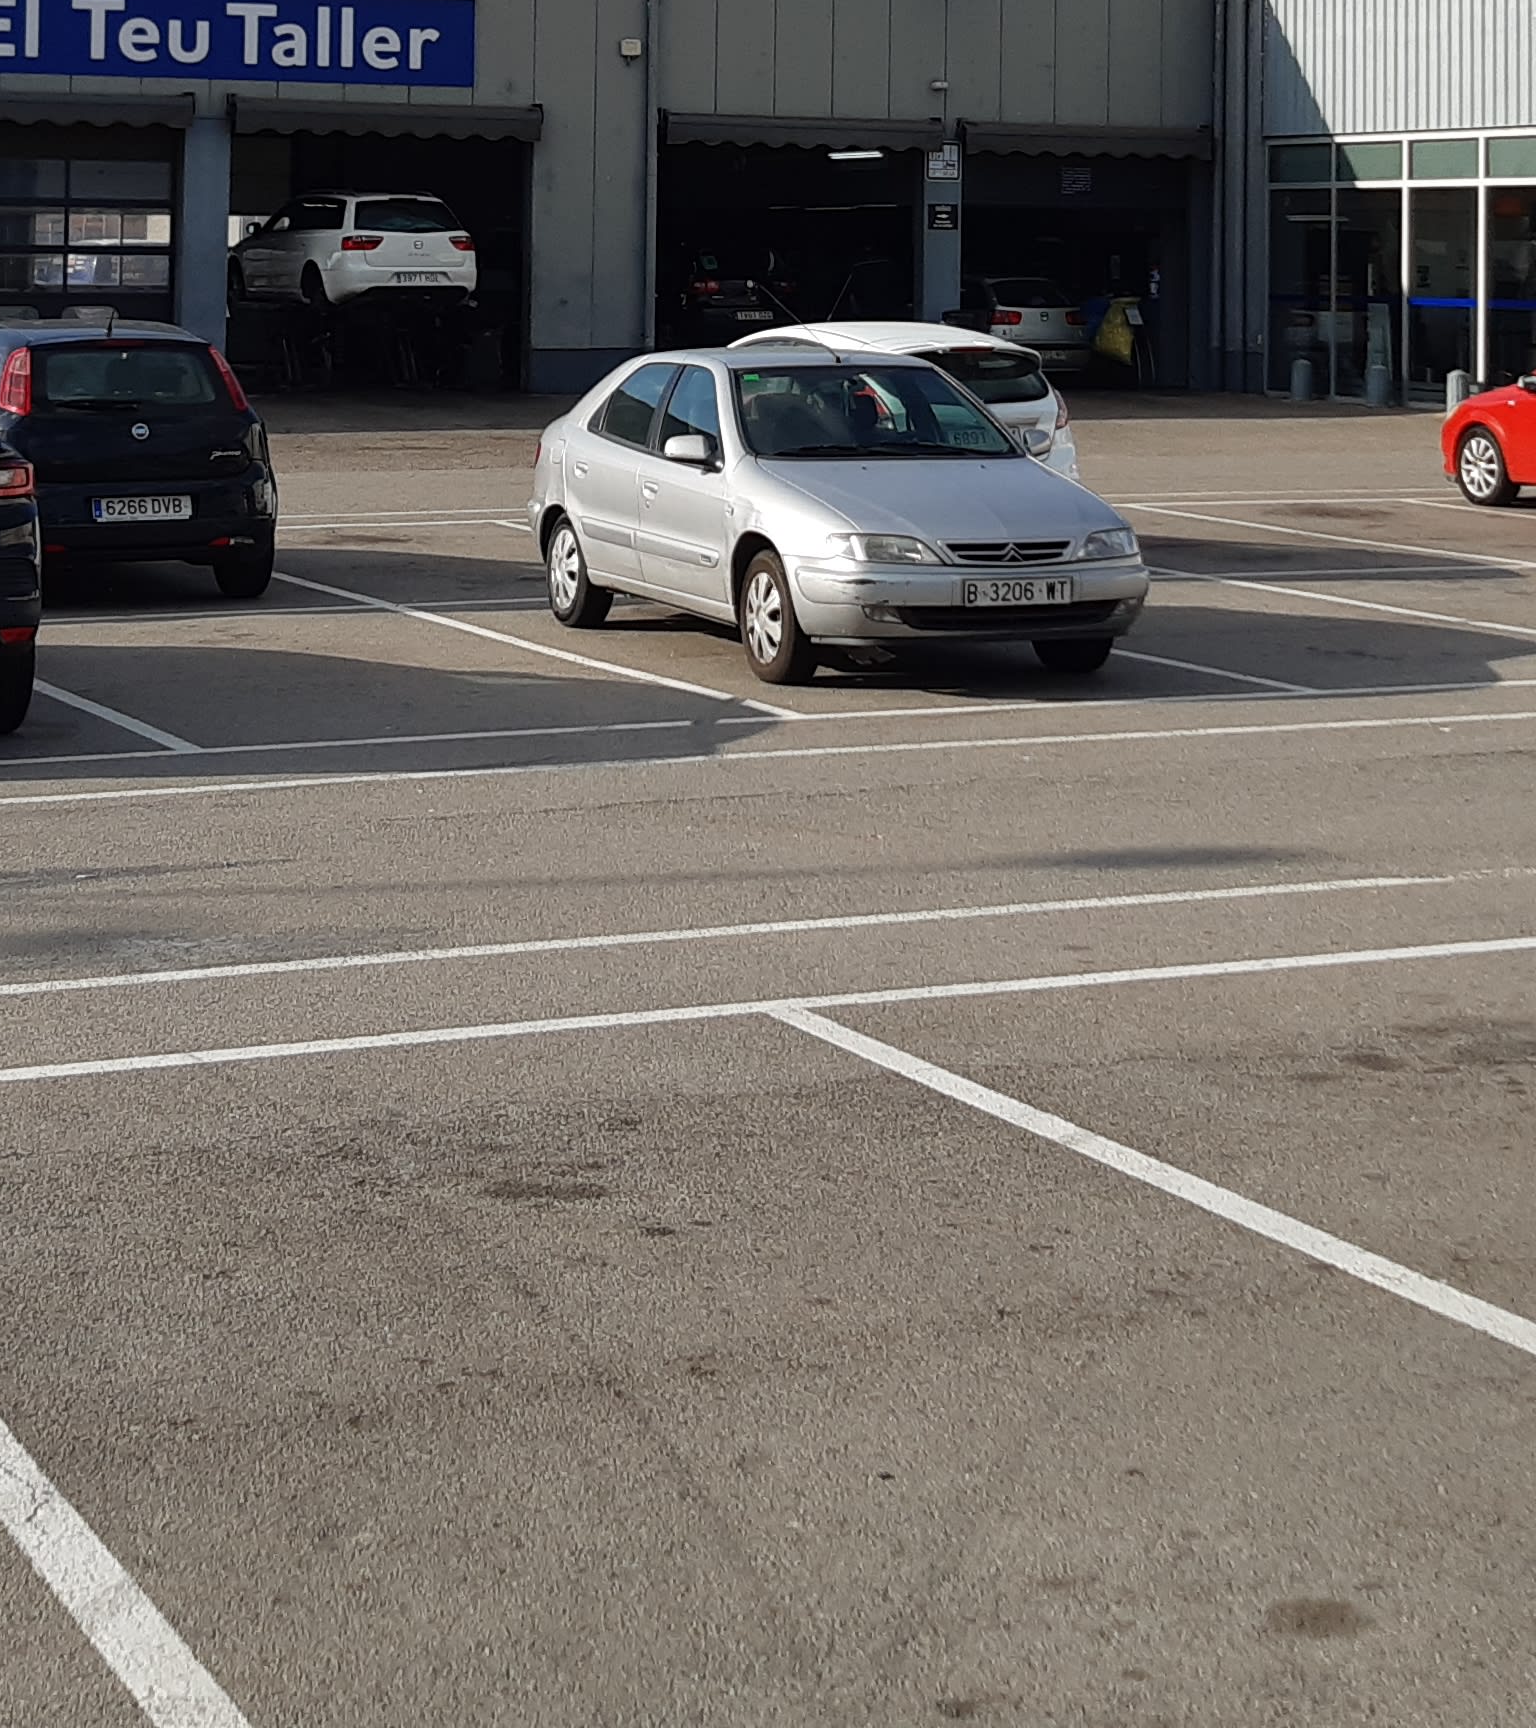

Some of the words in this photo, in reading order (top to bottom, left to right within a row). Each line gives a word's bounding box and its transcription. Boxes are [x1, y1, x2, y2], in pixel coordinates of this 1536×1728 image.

[226, 2, 441, 70] Taller
[105, 499, 148, 516] 6266
[151, 498, 183, 514] DVB
